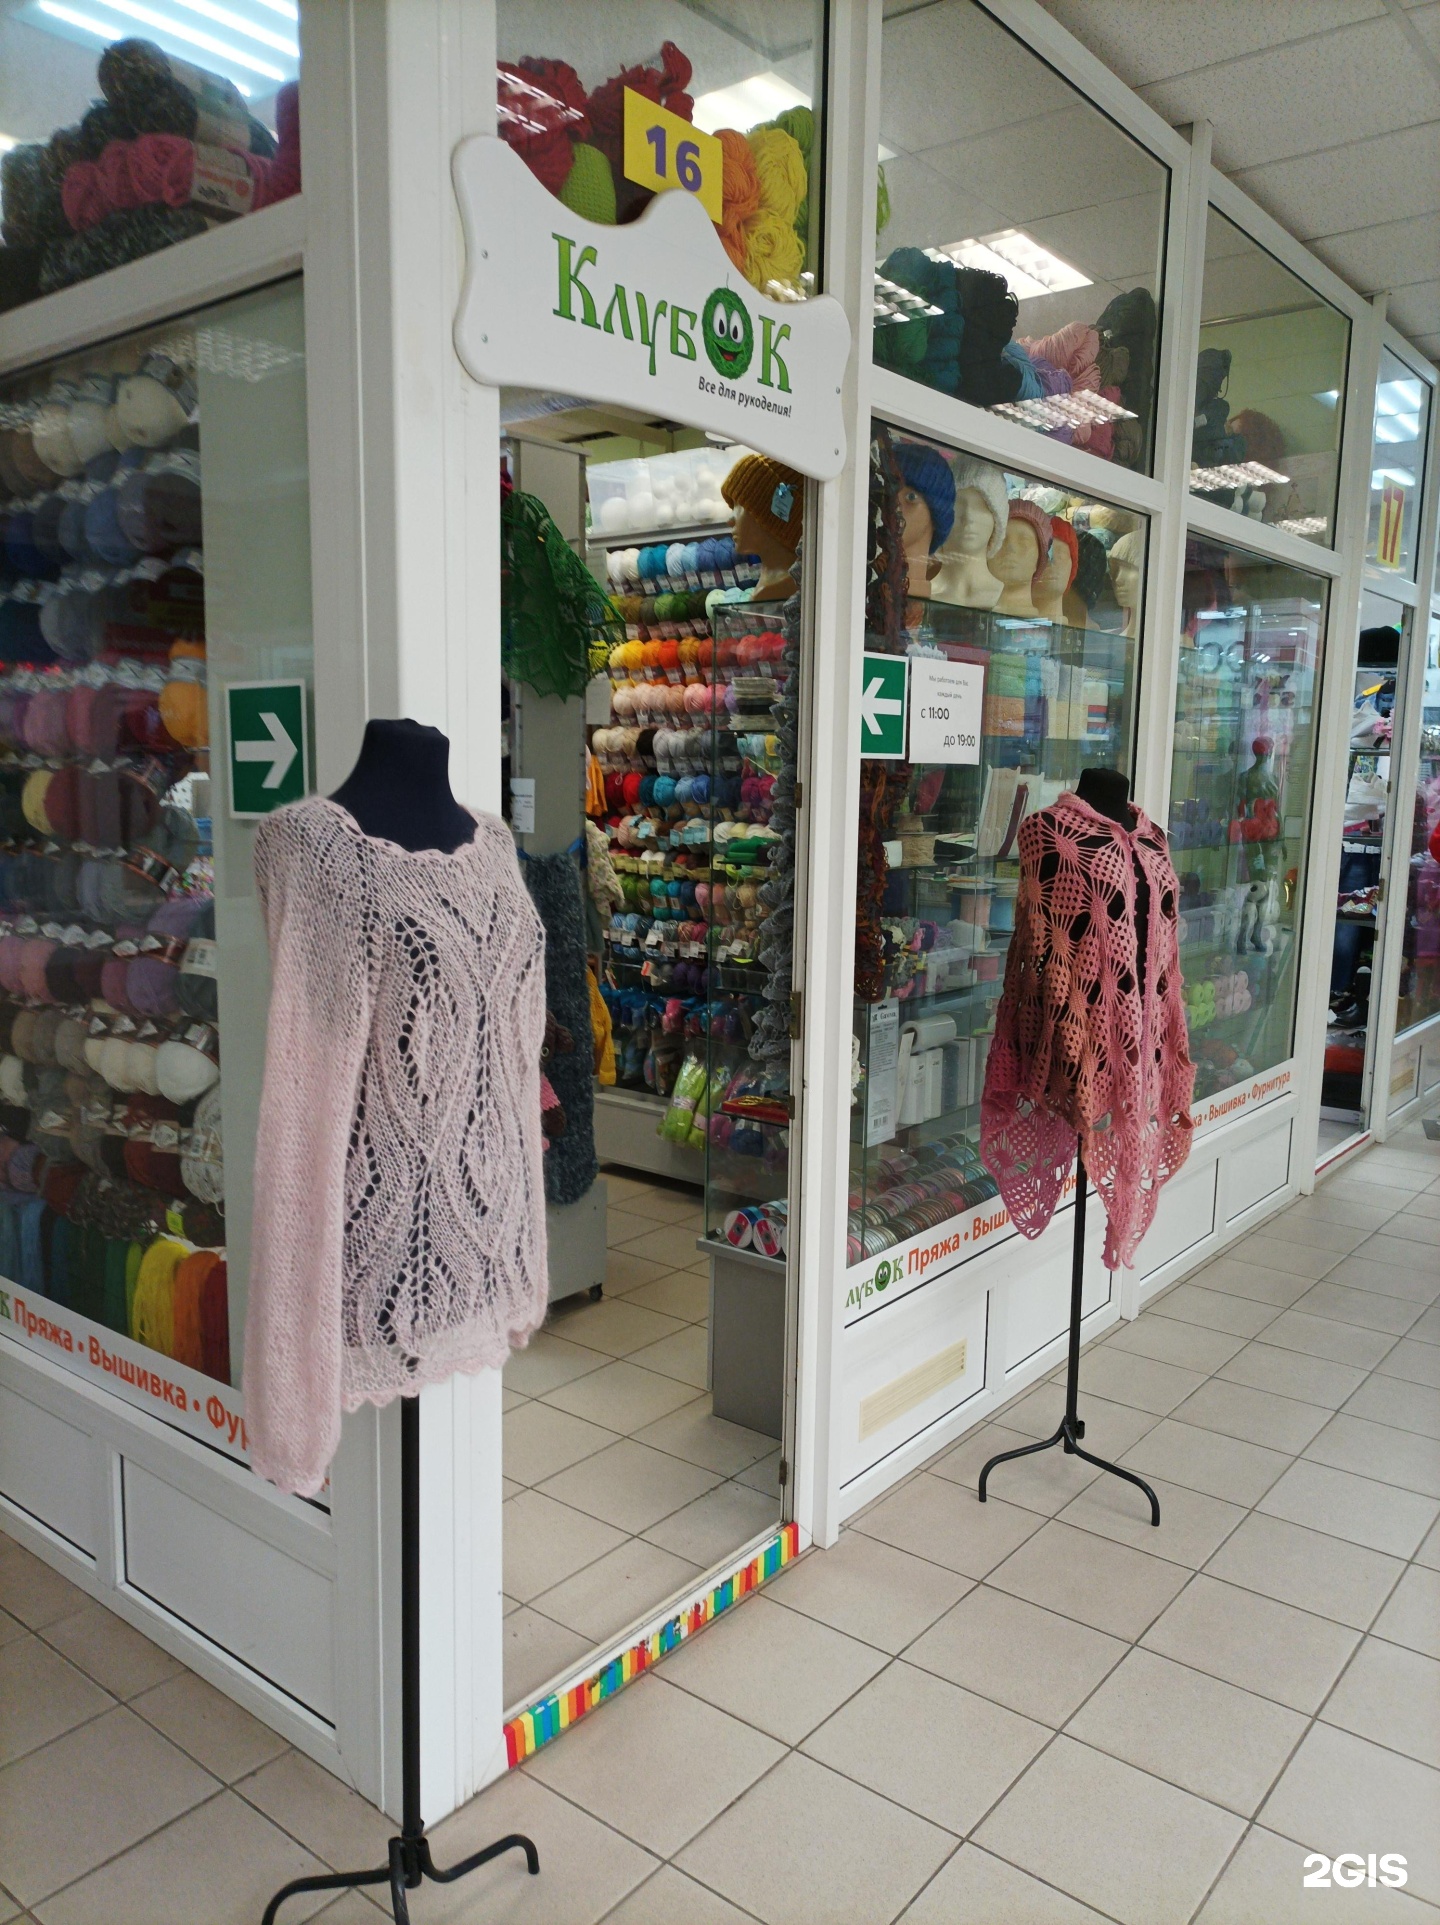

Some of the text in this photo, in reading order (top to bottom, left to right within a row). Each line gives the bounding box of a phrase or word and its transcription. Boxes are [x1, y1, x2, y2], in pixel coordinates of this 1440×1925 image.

[646, 124, 702, 192] 16
[698, 376, 793, 418] Все для рукоделия!
[928, 707, 950, 720] 11:00
[943, 734, 976, 748] до 19:00
[1208, 1092, 1246, 1121] Вышивка
[1252, 1071, 1291, 1101] Фурнитура
[908, 1233, 960, 1276] Пряжа
[14, 1297, 74, 1353] Пряжа
[88, 1335, 188, 1413] Вышивка
